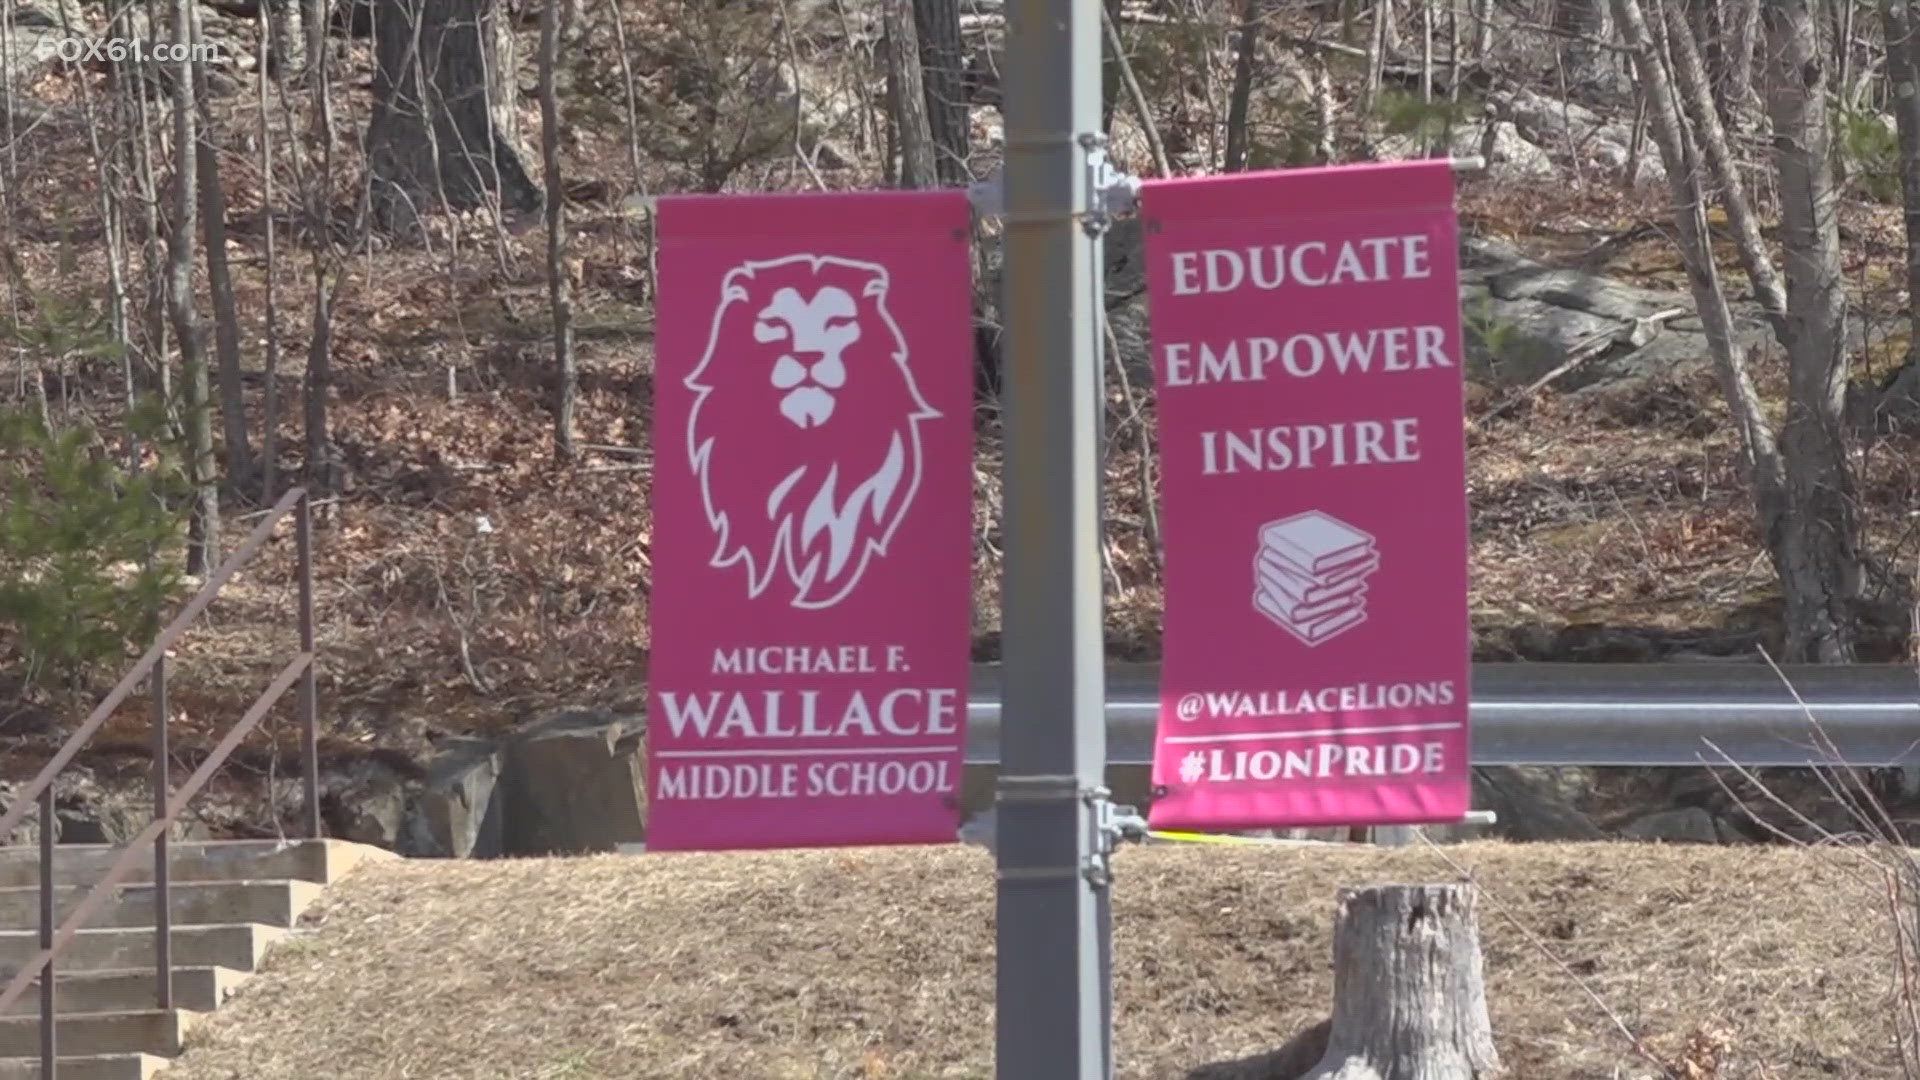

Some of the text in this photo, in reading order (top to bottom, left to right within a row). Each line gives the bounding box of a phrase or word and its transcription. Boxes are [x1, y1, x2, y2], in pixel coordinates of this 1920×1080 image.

[1171, 234, 1431, 296] EDUCATE
[1164, 325, 1453, 387] EMPOWER
[1202, 417, 1421, 475] INSPIRE
[712, 645, 910, 674] MICHAEL F.
[658, 688, 957, 738] WALLACE
[657, 760, 953, 800] MIDDLE SCHOOL
